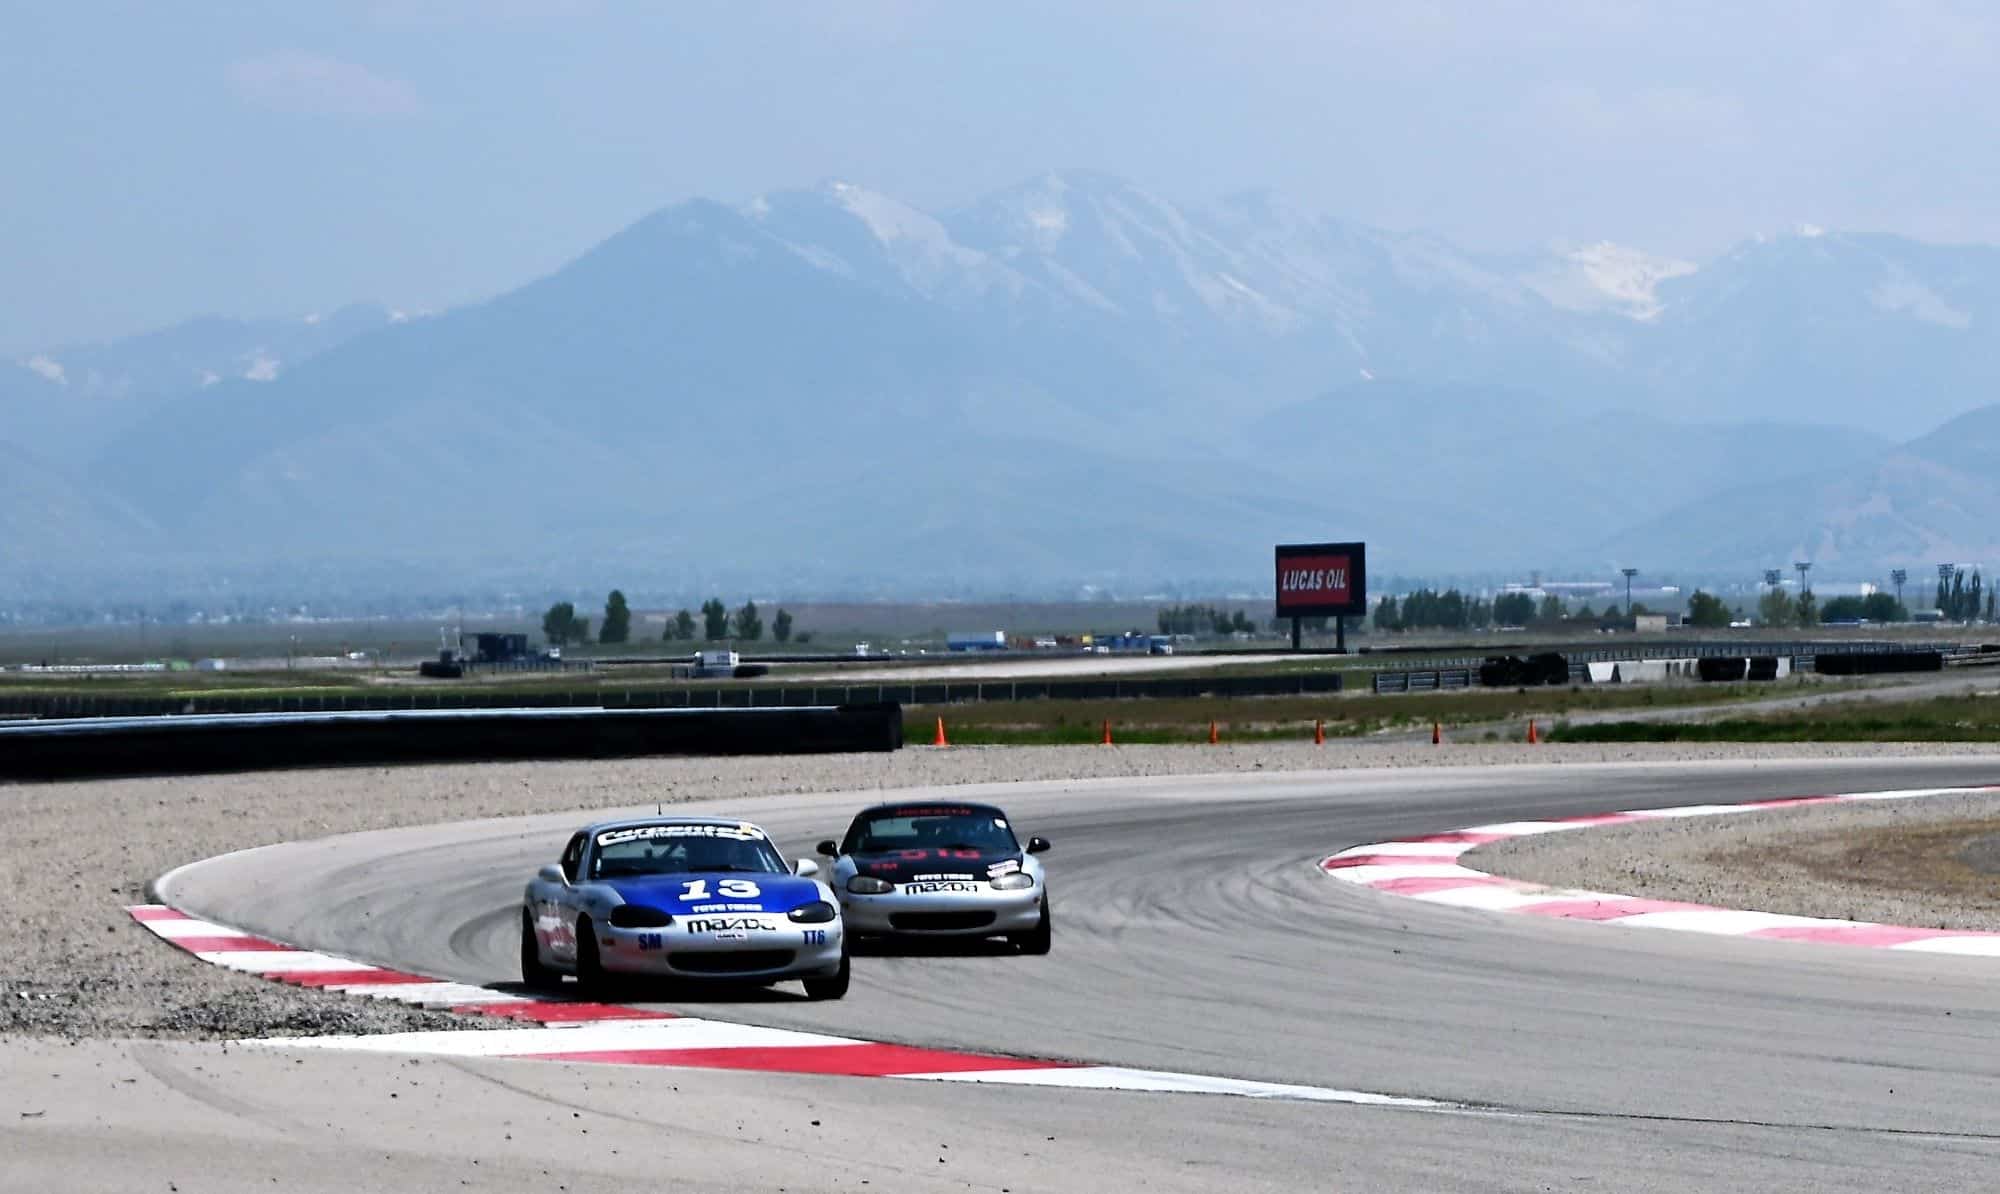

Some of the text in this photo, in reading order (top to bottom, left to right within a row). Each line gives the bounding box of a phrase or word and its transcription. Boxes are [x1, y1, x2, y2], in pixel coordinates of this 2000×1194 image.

[1282, 568, 1345, 591] LUCAS OIL
[679, 879, 761, 901] 13
[905, 882, 978, 895] mazda
[639, 933, 662, 950] SM
